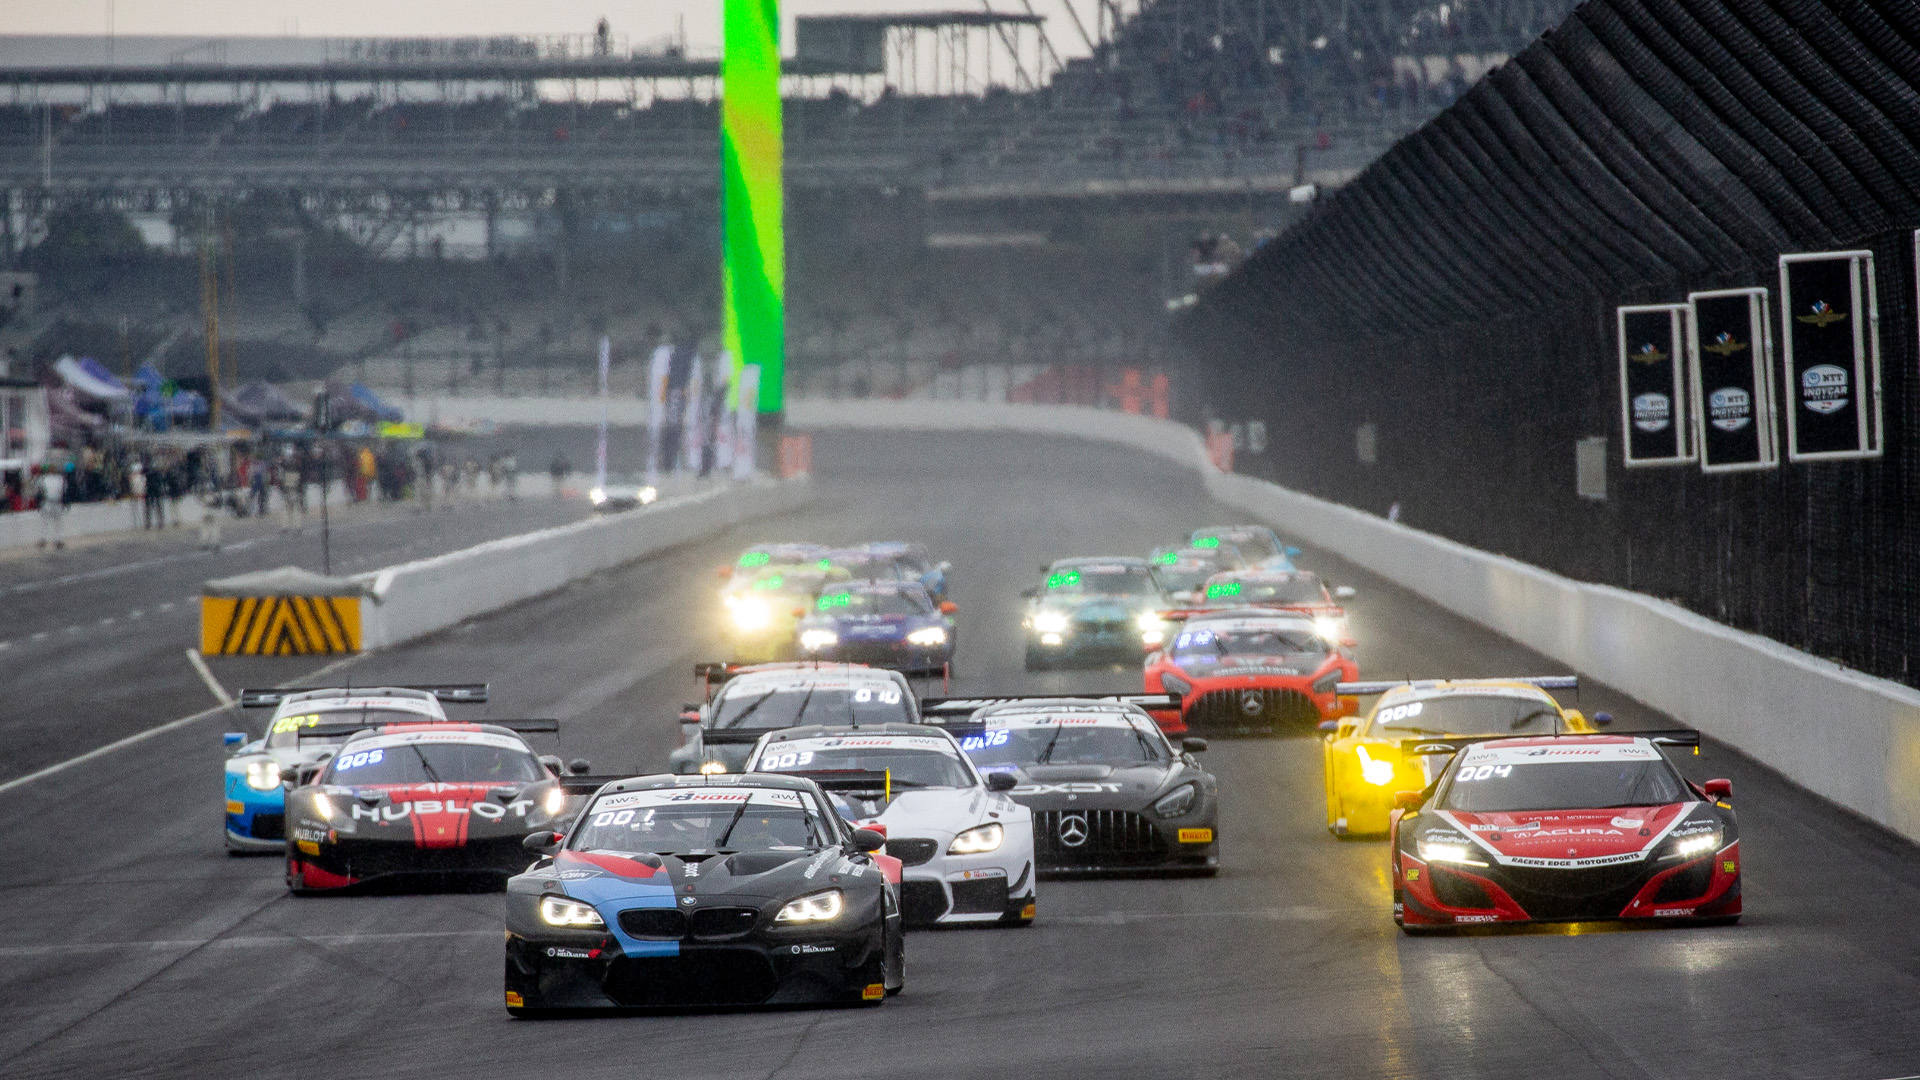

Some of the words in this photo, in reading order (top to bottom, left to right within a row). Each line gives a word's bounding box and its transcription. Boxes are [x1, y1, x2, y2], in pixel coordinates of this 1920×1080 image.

[1823, 373, 1843, 381] NTT
[1804, 386, 1847, 396] INDYCAR
[1728, 395, 1744, 403] NTT
[1712, 407, 1749, 416] INDYCAR
[909, 738, 939, 746] aws
[767, 743, 797, 752] aws
[336, 750, 383, 772] 005
[761, 751, 815, 771] 003
[1467, 753, 1498, 761] aws
[1456, 764, 1513, 782] 004
[605, 795, 639, 806] aws
[352, 800, 534, 822] HUBLOT
[593, 809, 656, 827] 001
[294, 828, 327, 843] HUBLOT
[1533, 829, 1624, 837] ACURA
[1511, 857, 1545, 866] RACERS
[1576, 853, 1640, 866] MOTORSPORTS
